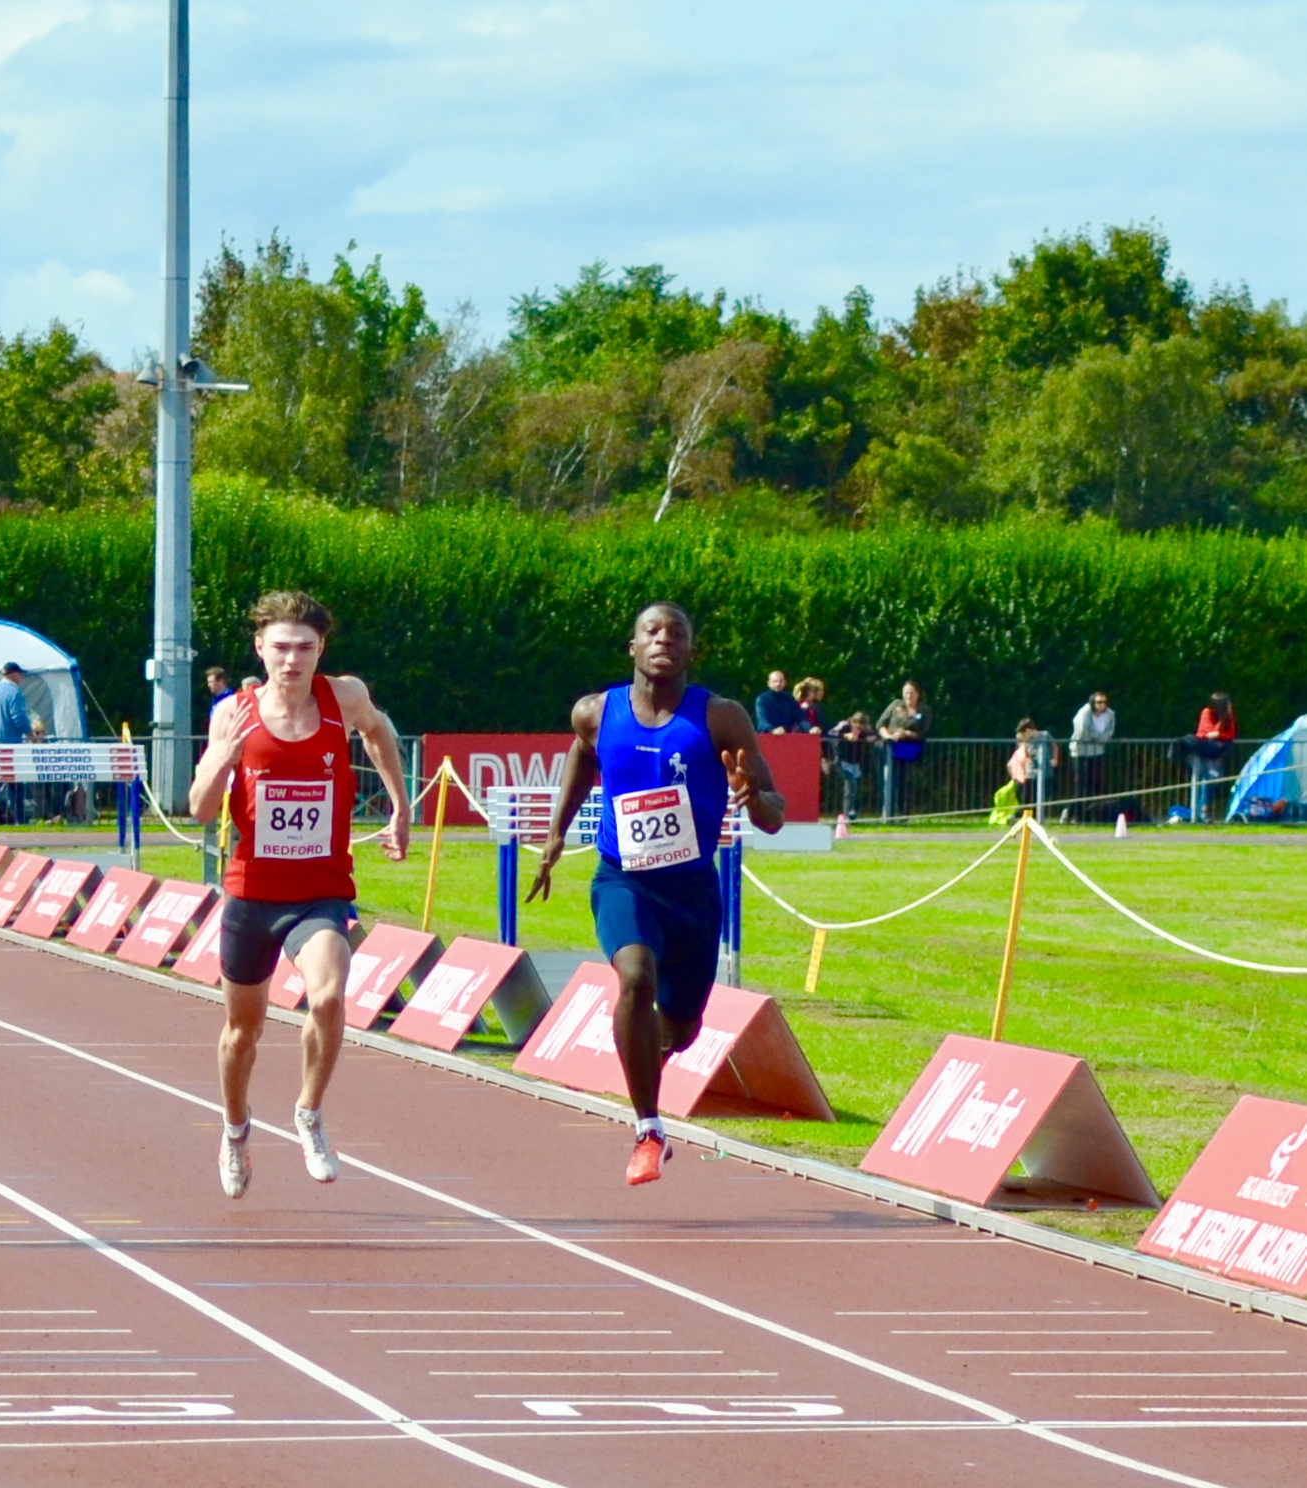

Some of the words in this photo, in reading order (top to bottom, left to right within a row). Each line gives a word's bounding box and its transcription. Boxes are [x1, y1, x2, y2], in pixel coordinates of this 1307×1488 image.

[37, 773, 97, 781] BEDFORD
[268, 788, 287, 799] DW
[270, 807, 320, 831] 849
[630, 812, 681, 843] 828
[263, 844, 323, 856] BEDFORD
[629, 848, 692, 869] BEDFORD
[890, 1058, 980, 1157] DW
